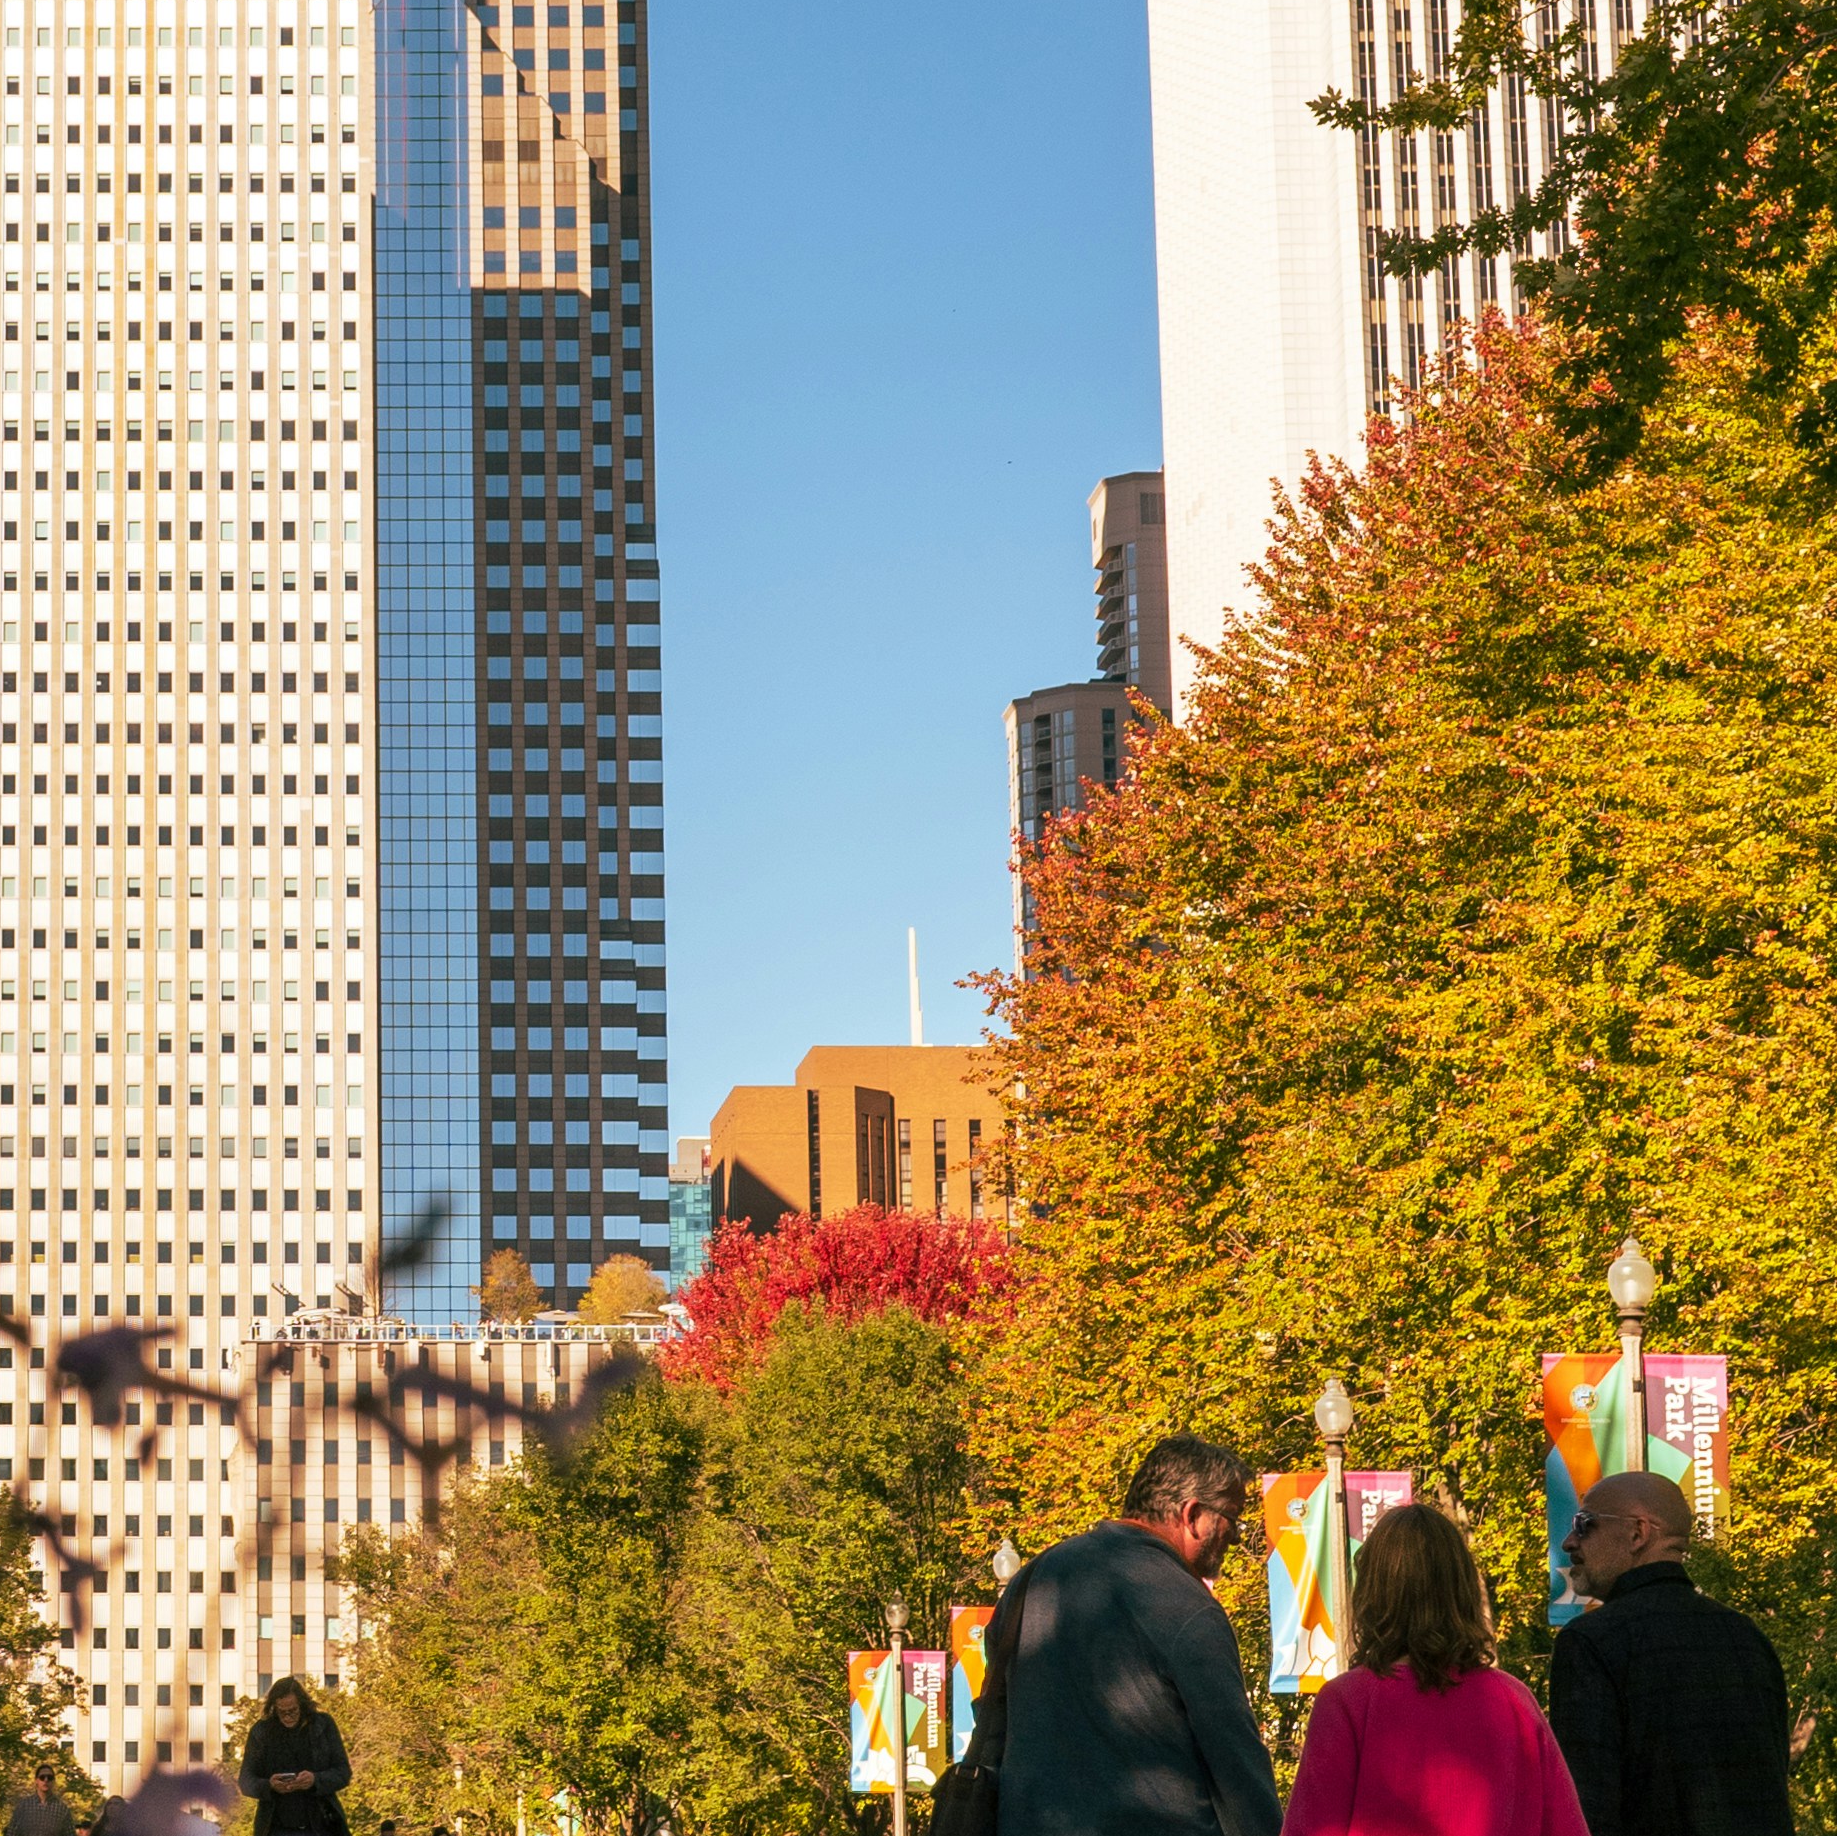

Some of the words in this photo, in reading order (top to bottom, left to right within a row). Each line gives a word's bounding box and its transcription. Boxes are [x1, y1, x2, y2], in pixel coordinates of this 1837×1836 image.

[1664, 1376, 1692, 1441] Park
[1361, 1489, 1383, 1542] Par
[913, 1662, 928, 1696] Park
[927, 1662, 942, 1749] Millennium
